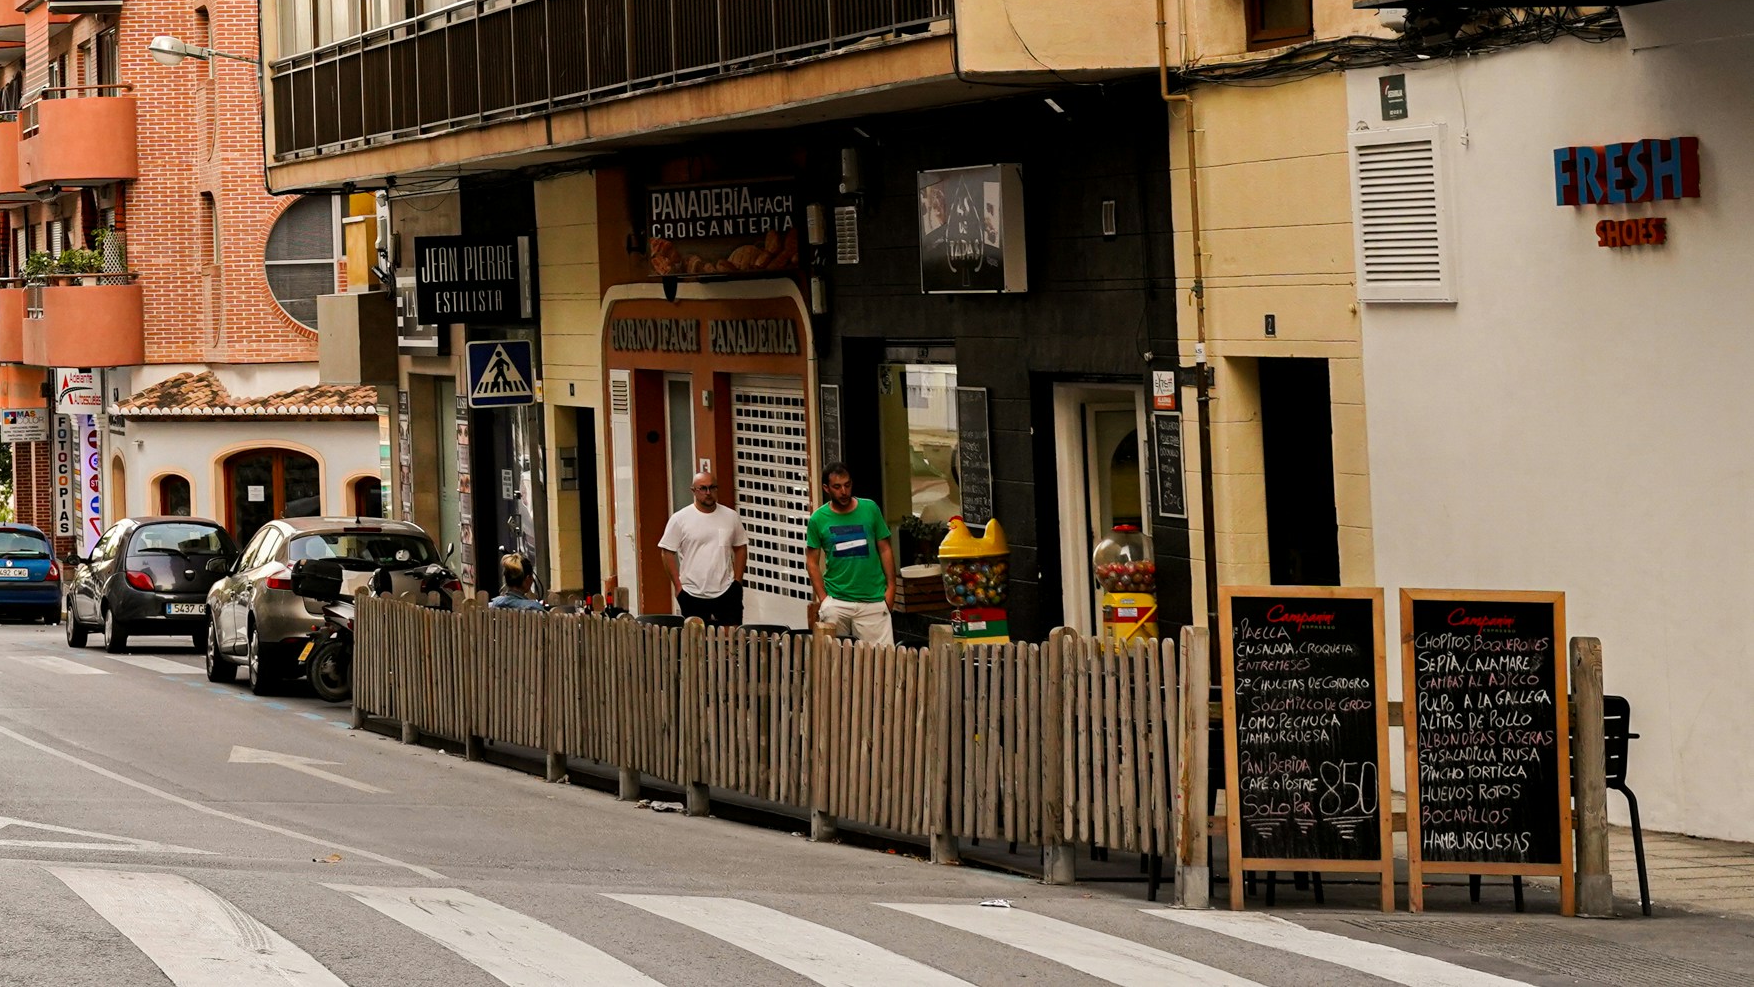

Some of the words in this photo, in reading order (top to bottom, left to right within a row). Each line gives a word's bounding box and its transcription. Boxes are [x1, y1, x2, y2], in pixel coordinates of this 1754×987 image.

[1554, 137, 1683, 206] FRESH
[651, 186, 752, 221] PANADERÍA
[754, 195, 793, 214] IFACH
[1596, 217, 1658, 247] SHOES
[421, 247, 458, 283] JEAN
[464, 245, 514, 281] PIERRE
[436, 290, 502, 313] ESTILISTA
[611, 319, 654, 350] HORNO
[657, 319, 699, 351] IFACH
[709, 320, 797, 353] PANADERIA
[16, 410, 36, 418] MAS
[16, 416, 45, 424] COLOR
[57, 417, 70, 533] FOTOCOPIAS
[174, 604, 195, 613] 5437
[1267, 604, 1335, 632] Campanini
[1447, 607, 1516, 636] Campanini
[1236, 658, 1311, 672] ENTREMESES
[1251, 676, 1305, 691] CHULETAS
[1418, 673, 1465, 691] GAMBAS
[1468, 675, 1484, 688] AL
[1339, 697, 1372, 712] CERDO
[1419, 691, 1455, 712] PULPO
[1464, 693, 1473, 710] A
[1477, 692, 1493, 709] LA
[1495, 689, 1552, 706] GALLEGA
[1468, 712, 1484, 730] DE
[1489, 709, 1533, 728] POLLO
[1240, 729, 1330, 746] HAMBURGUESA
[1498, 730, 1554, 747] CASERAS
[1502, 747, 1541, 763] RUSA
[1281, 774, 1319, 792] POSTRE
[1421, 784, 1474, 802] HUEVOS
[1243, 794, 1291, 818] SOLO
[1423, 830, 1532, 853] HAMBURGUESAS
